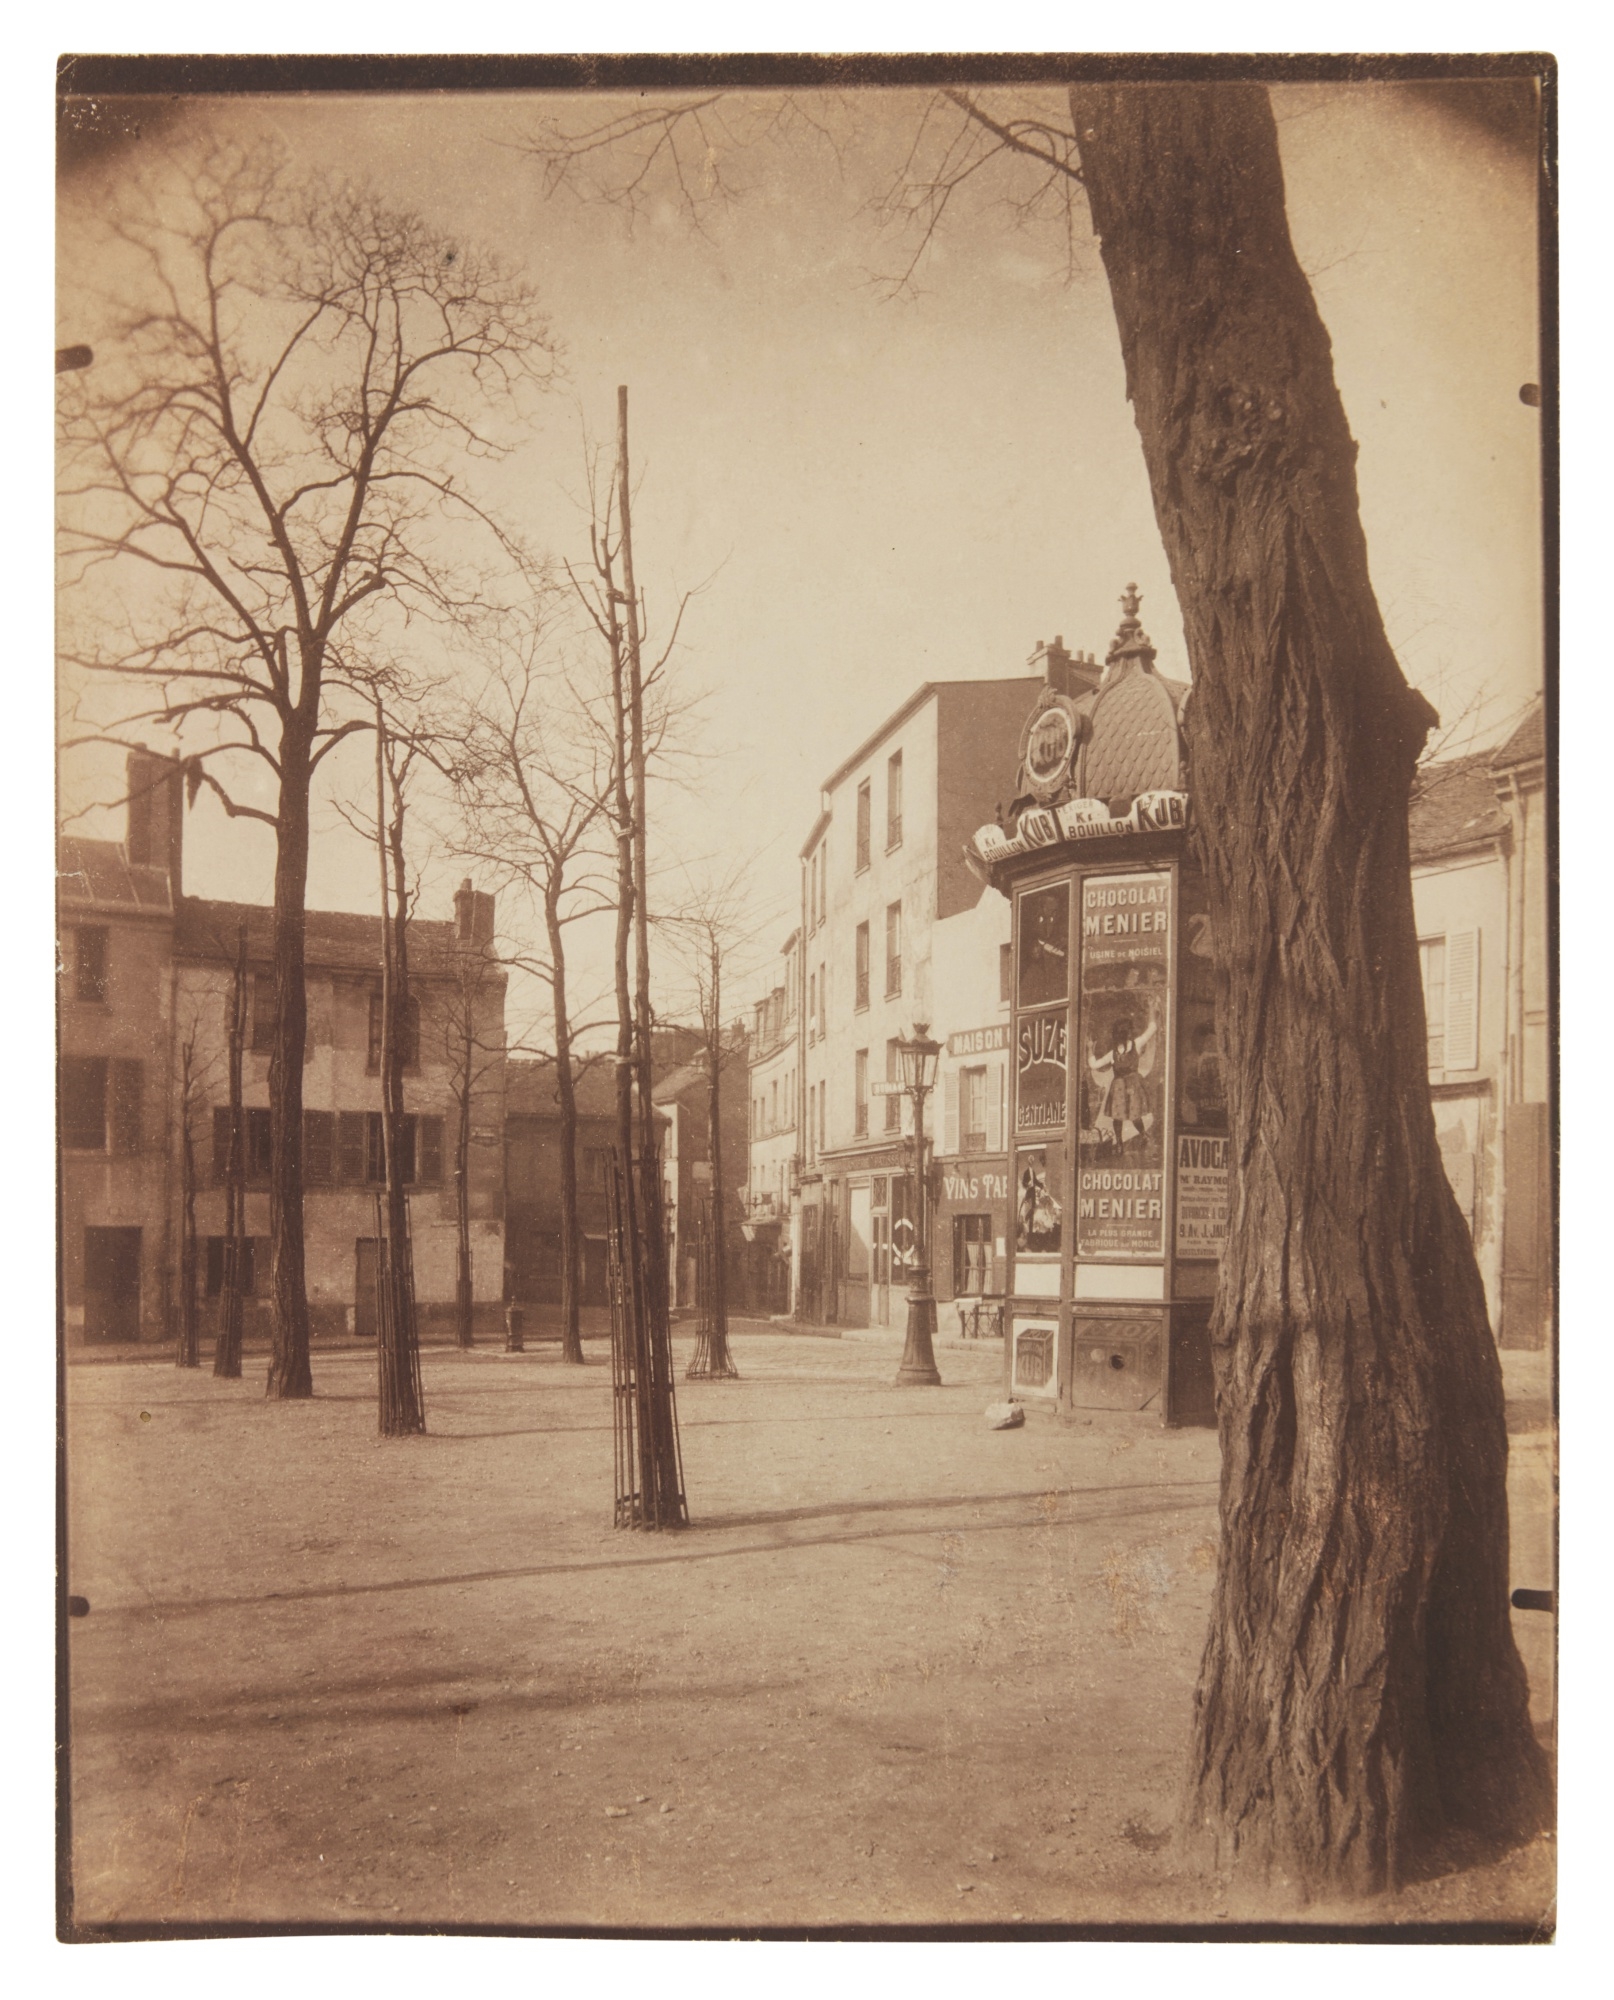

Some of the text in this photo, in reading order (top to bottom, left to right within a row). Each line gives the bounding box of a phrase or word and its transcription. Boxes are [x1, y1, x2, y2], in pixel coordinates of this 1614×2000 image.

[983, 840, 1027, 862] BOUILLON
[1019, 813, 1056, 850] KUB
[1068, 820, 1134, 839] BOUILLON
[1087, 886, 1167, 908] CHOCOLAT
[1086, 911, 1168, 936] MENIER
[1089, 950, 1115, 959] USINE
[1128, 947, 1163, 957] NOISIEL
[953, 1027, 1003, 1055] MAISON
[1018, 1019, 1067, 1073] SUZE
[1018, 1102, 1067, 1127] GENTIANE
[943, 1176, 979, 1200] VINS
[1082, 1173, 1162, 1191] CHOCOLAT
[1080, 1198, 1162, 1218] MENIER
[1080, 1239, 1119, 1247] FABRIQUE
[1131, 1240, 1160, 1248] MONDE
[1088, 1229, 1153, 1238] LA PLUS GRANDE
